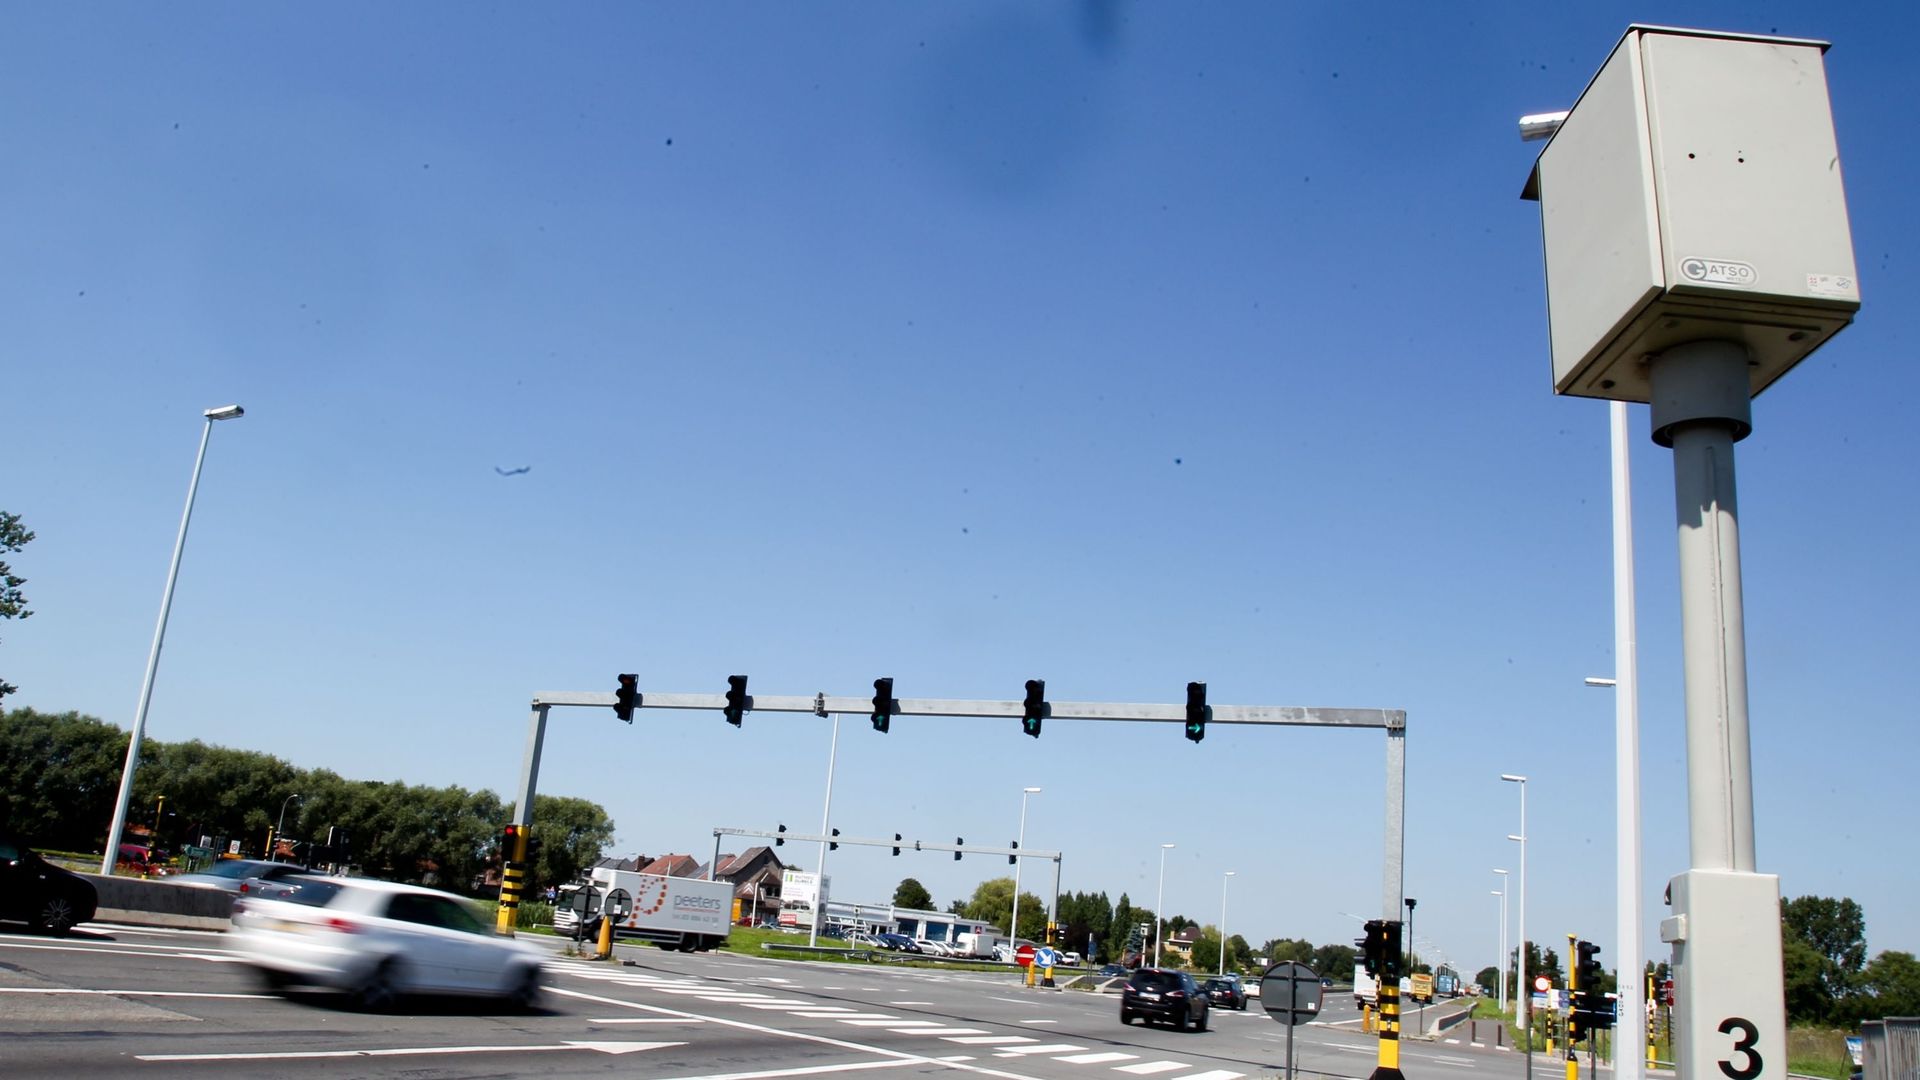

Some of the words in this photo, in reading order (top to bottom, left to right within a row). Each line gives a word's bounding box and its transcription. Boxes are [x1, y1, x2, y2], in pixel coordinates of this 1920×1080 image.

[1682, 258, 1749, 280] GATSO
[674, 895, 720, 910] peeters
[1717, 1017, 1764, 1080] 3
